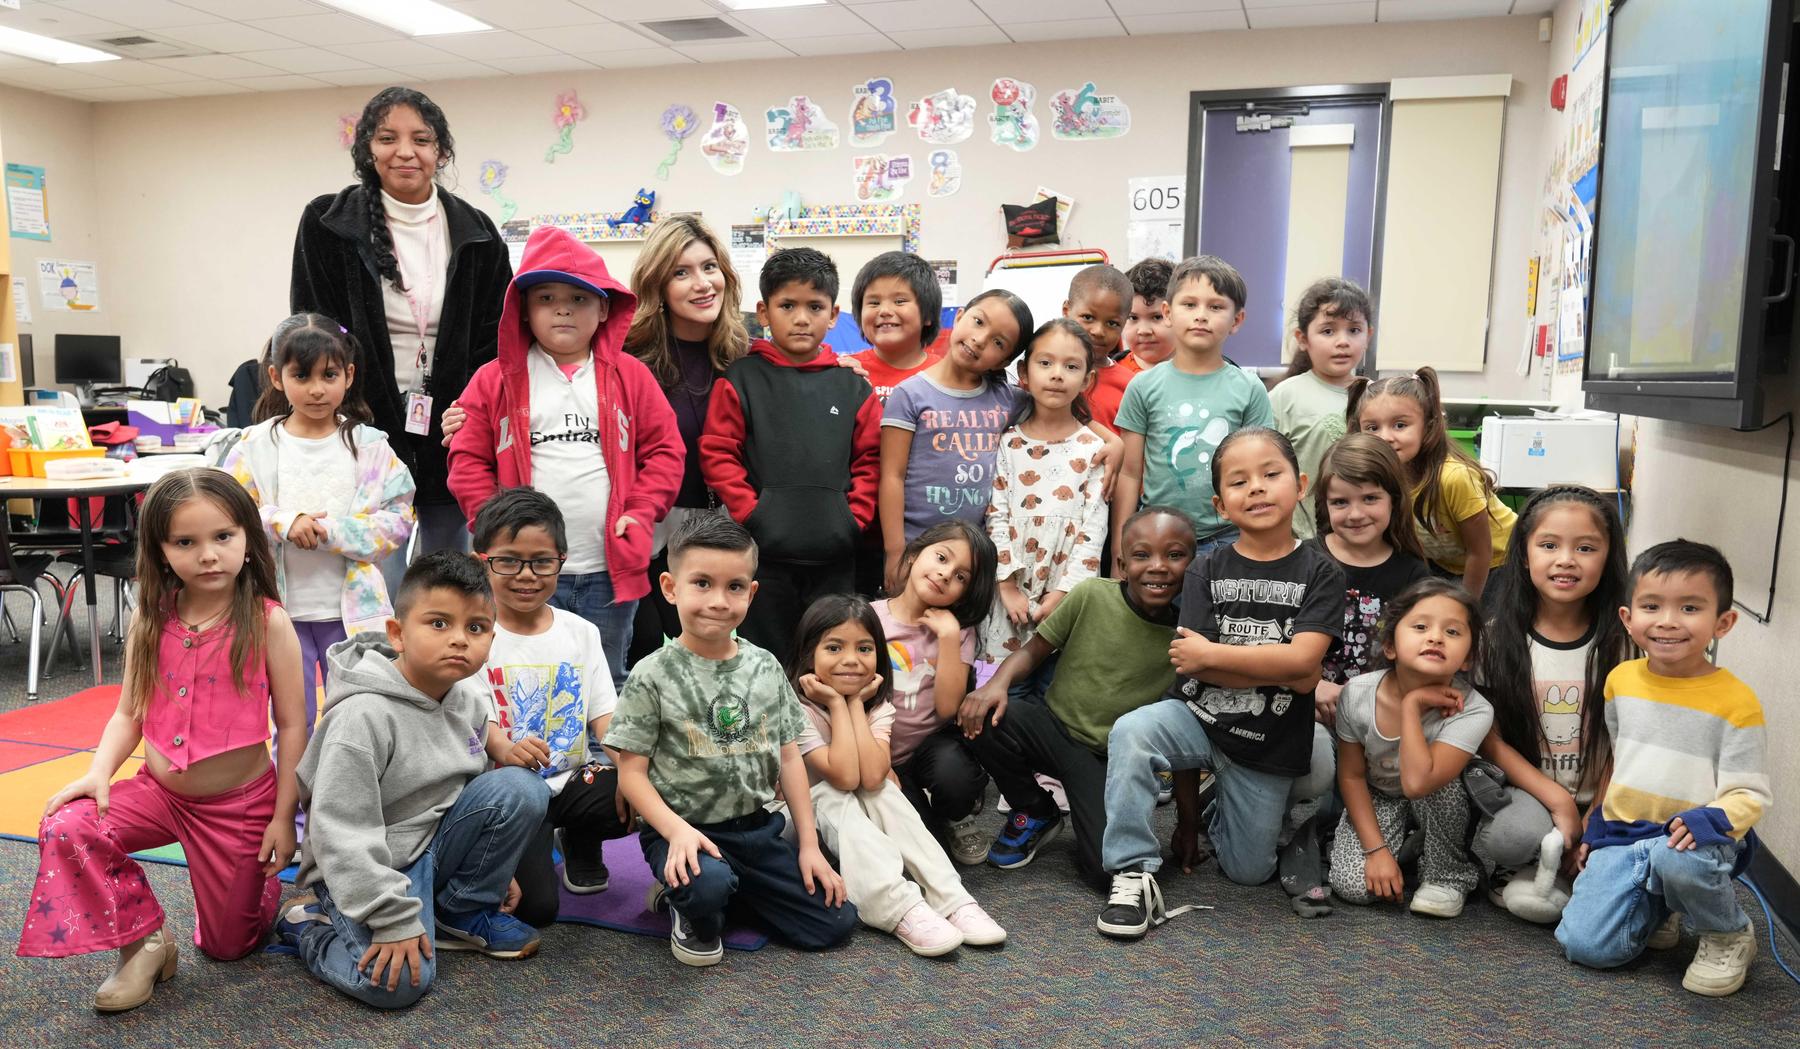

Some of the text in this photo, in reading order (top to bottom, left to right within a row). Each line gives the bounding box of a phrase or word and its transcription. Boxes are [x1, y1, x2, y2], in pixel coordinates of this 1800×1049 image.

[866, 80, 895, 114] 3
[1133, 187, 1180, 211] 605
[565, 413, 590, 429] Fly
[530, 429, 601, 446] Emirat
[932, 431, 1000, 461] CALLE
[955, 463, 984, 484] SO
[1228, 623, 1270, 635] ROUTE
[1275, 702, 1289, 712] 66
[1229, 726, 1265, 742] AMERICA
